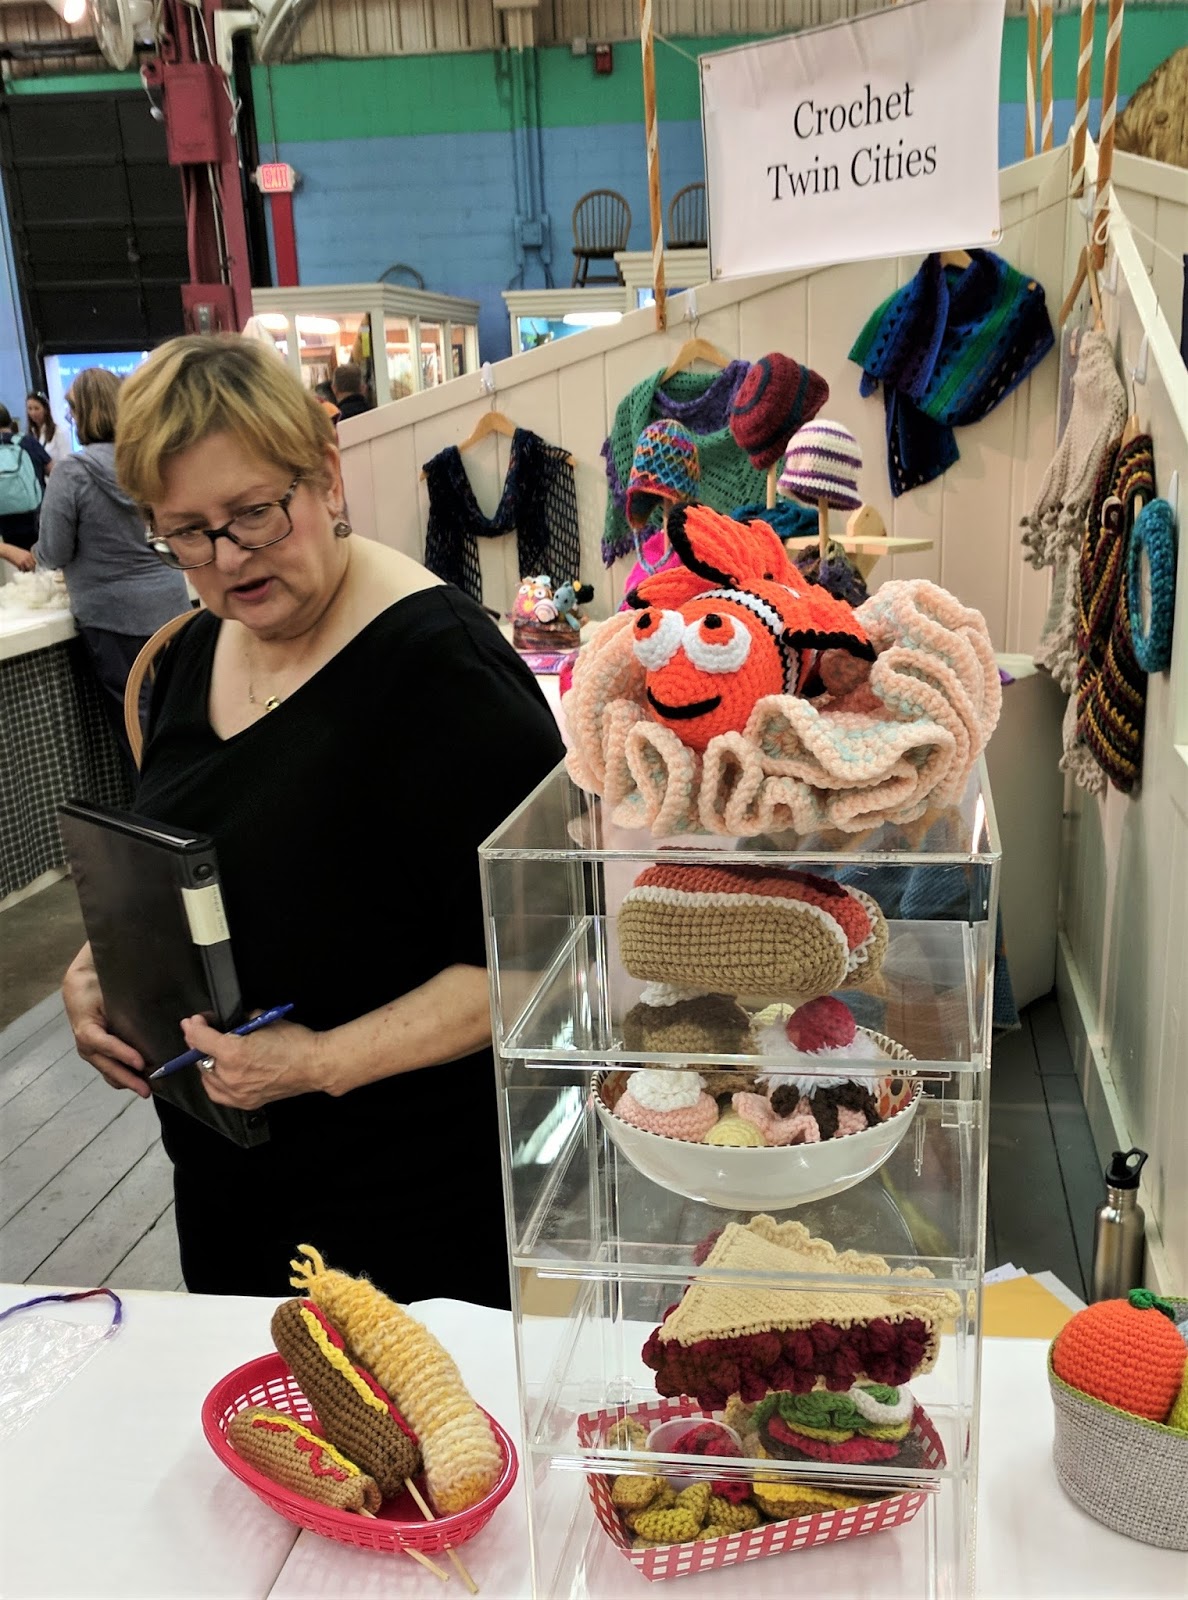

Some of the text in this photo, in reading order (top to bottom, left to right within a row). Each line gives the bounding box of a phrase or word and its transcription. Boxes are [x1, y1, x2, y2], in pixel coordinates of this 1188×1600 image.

[793, 81, 915, 139] Crochet
[262, 165, 288, 189] EXIT
[767, 138, 937, 201] Twin Cities
